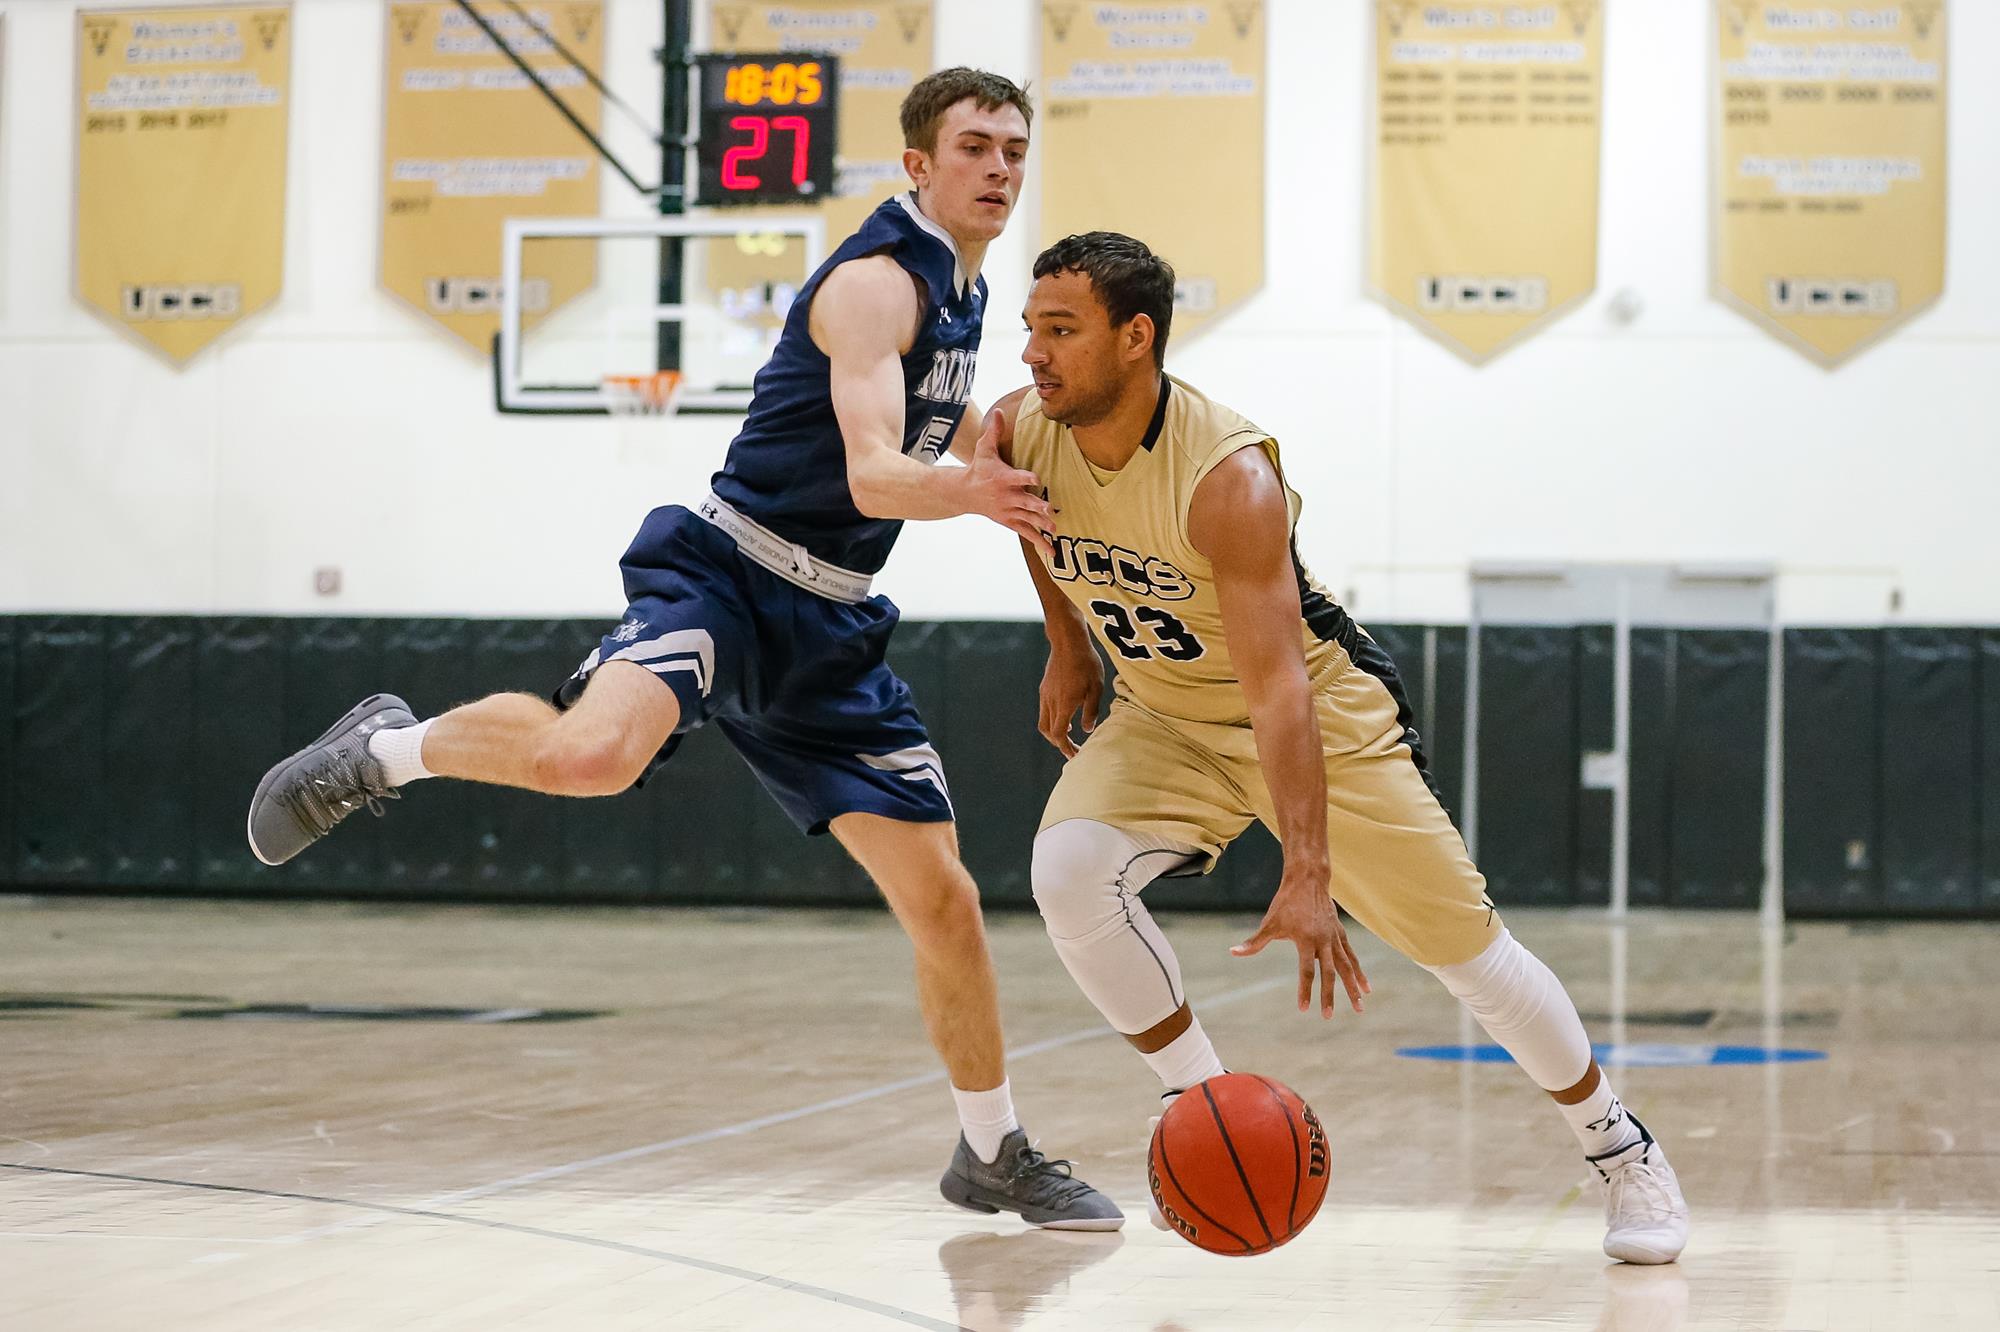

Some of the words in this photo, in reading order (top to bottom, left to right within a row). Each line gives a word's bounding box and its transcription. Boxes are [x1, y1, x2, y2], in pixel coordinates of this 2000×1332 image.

[724, 62, 822, 105] 18:05
[721, 115, 810, 190] 27
[424, 276, 551, 316] UCS
[1040, 530, 1196, 601] UCCS
[1089, 598, 1206, 662] 23
